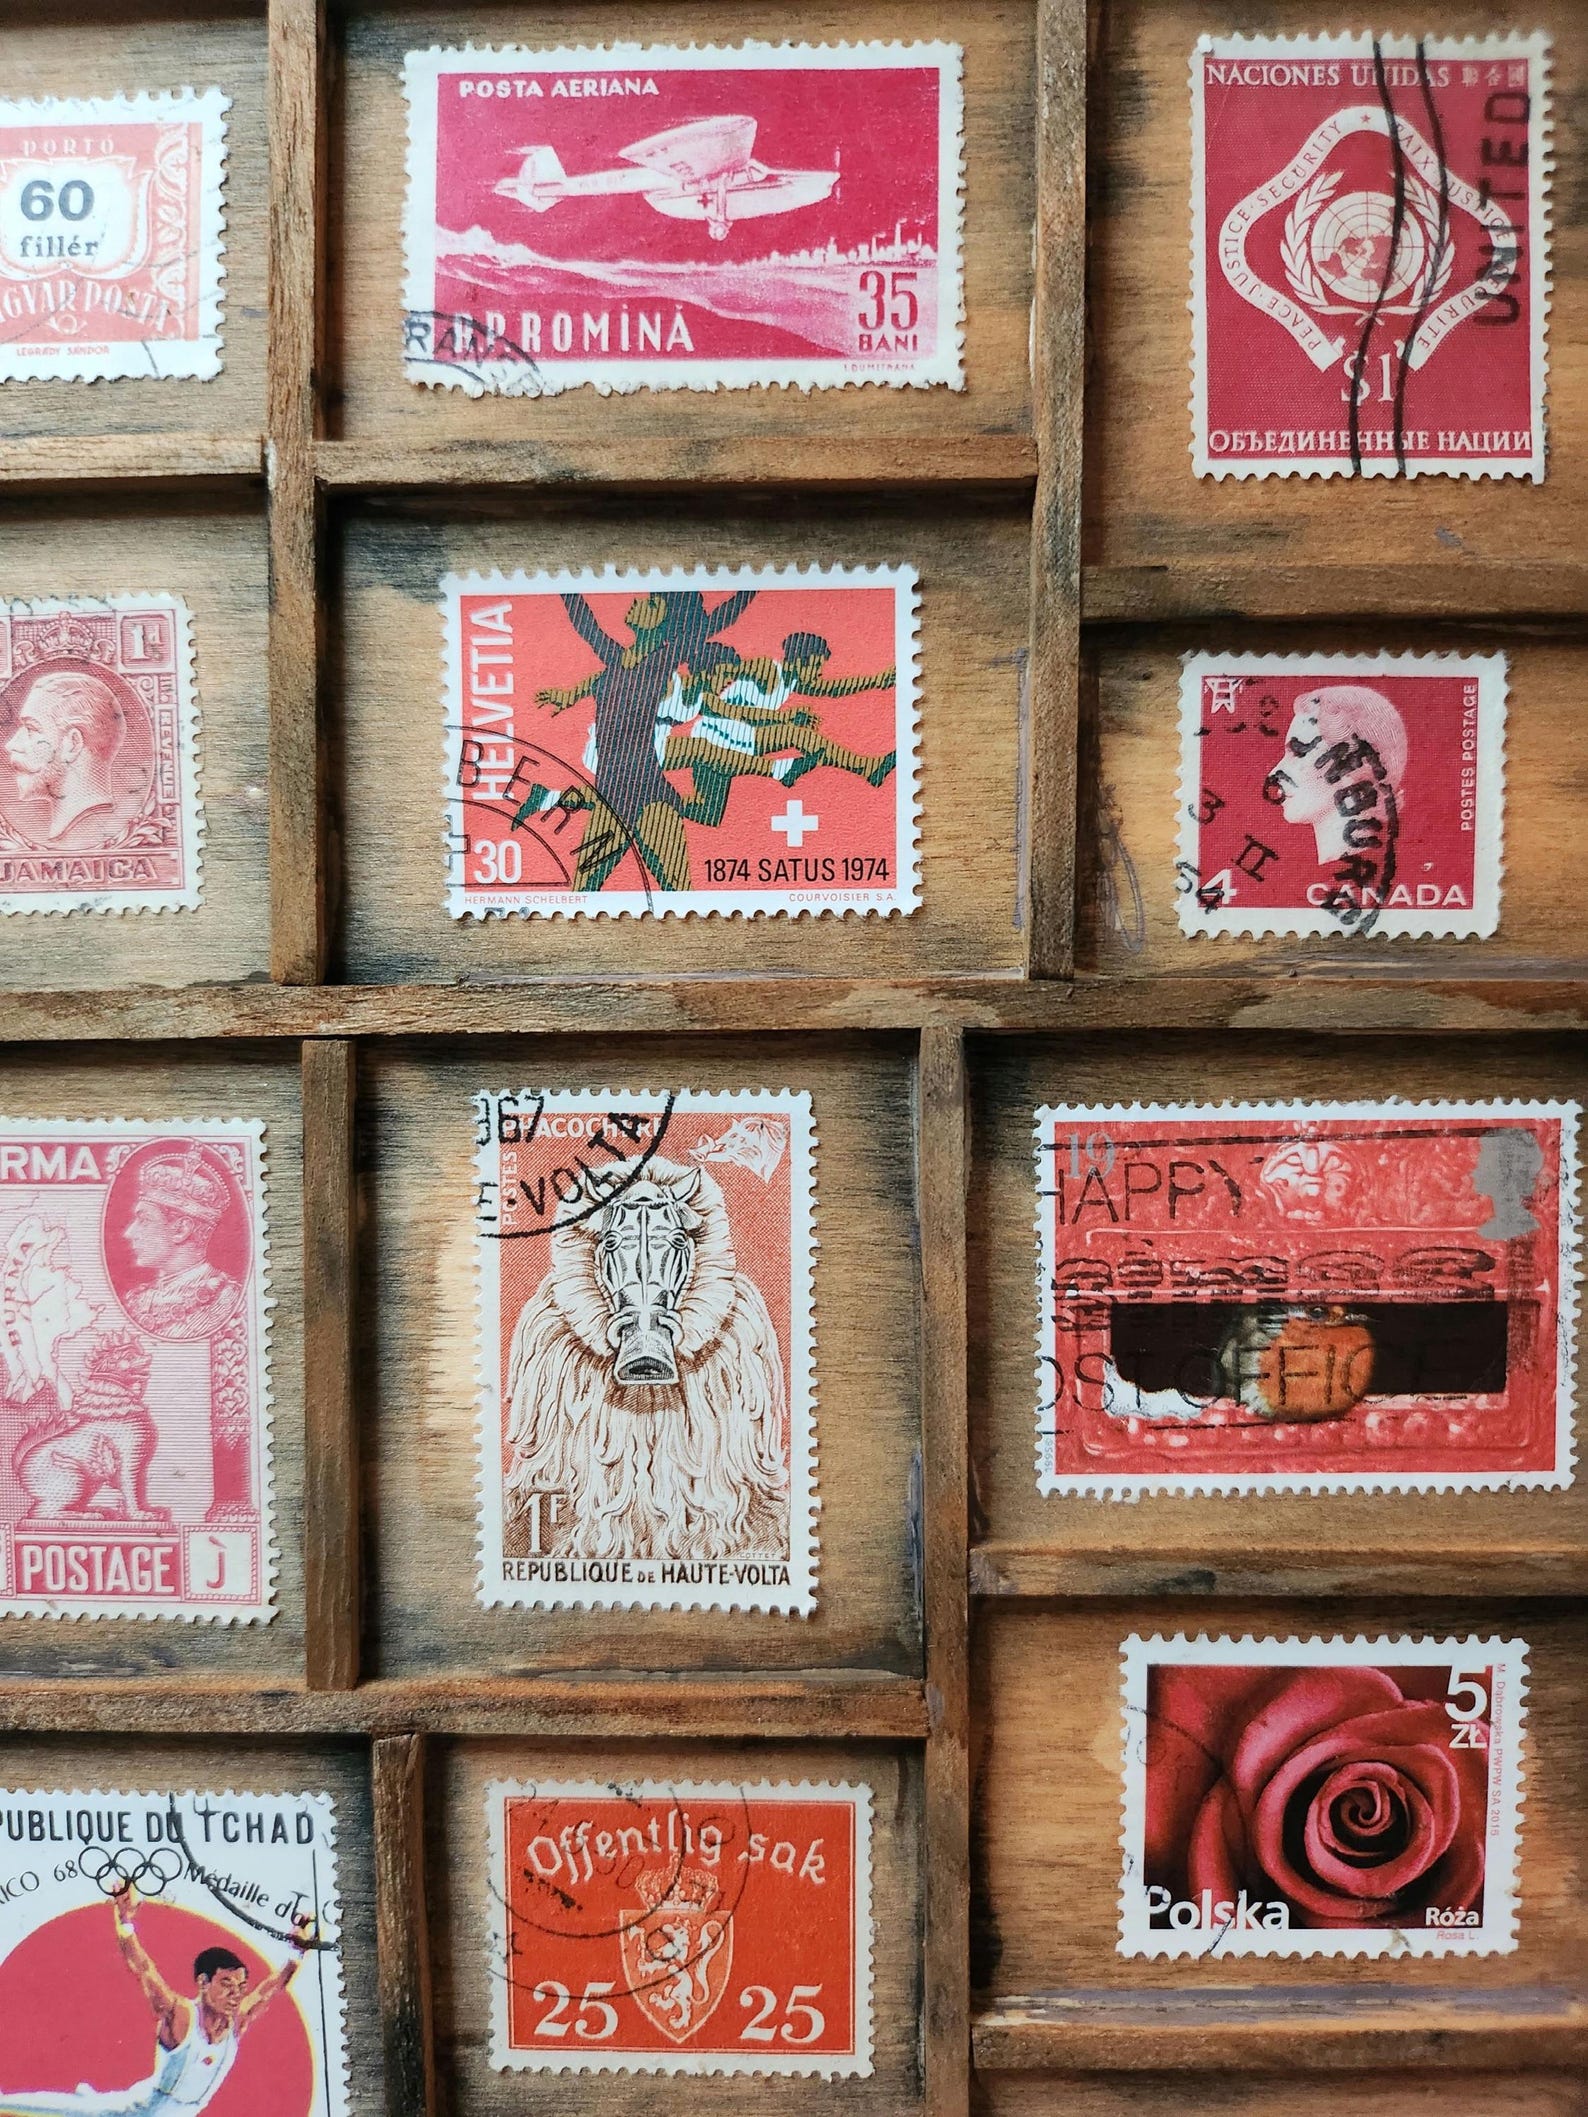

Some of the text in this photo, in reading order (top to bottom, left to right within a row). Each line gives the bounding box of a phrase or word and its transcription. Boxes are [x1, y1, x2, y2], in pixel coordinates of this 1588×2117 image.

[1205, 63, 1341, 88] NACIONES
[19, 178, 96, 222] 60
[19, 233, 100, 259] fillér
[858, 269, 918, 331] 35
[858, 333, 918, 353] BANI
[1437, 429, 1533, 455] НАЦИИ
[470, 599, 515, 801] HELVETIA
[160, 708, 176, 799] REVENUE
[1460, 683, 1478, 831] POSTES POSTAGE
[456, 738, 624, 874] BERN
[473, 838, 523, 885] 30
[704, 856, 890, 883] 1874 SATUS 1974
[463, 894, 589, 905] HERMANN SCHELBERT
[788, 892, 871, 903] COURVOISIER
[1305, 881, 1468, 907] CANADA
[0, 1145, 103, 1181] RMA
[1062, 1129, 1118, 1181] 19
[22, 1544, 176, 1594] POSTAGE
[661, 1562, 791, 1586] HAUTE-VOLTA
[1444, 1664, 1488, 1723] 5
[200, 1810, 314, 1846] TCHAD
[527, 1808, 723, 1886] Offentlig
[53, 1859, 79, 1883] 68
[1143, 1884, 1291, 1931] Polska
[1424, 1905, 1480, 1928] Róża
[1436, 1930, 1465, 1941] Rosa
[532, 1980, 826, 2044] 25 25
